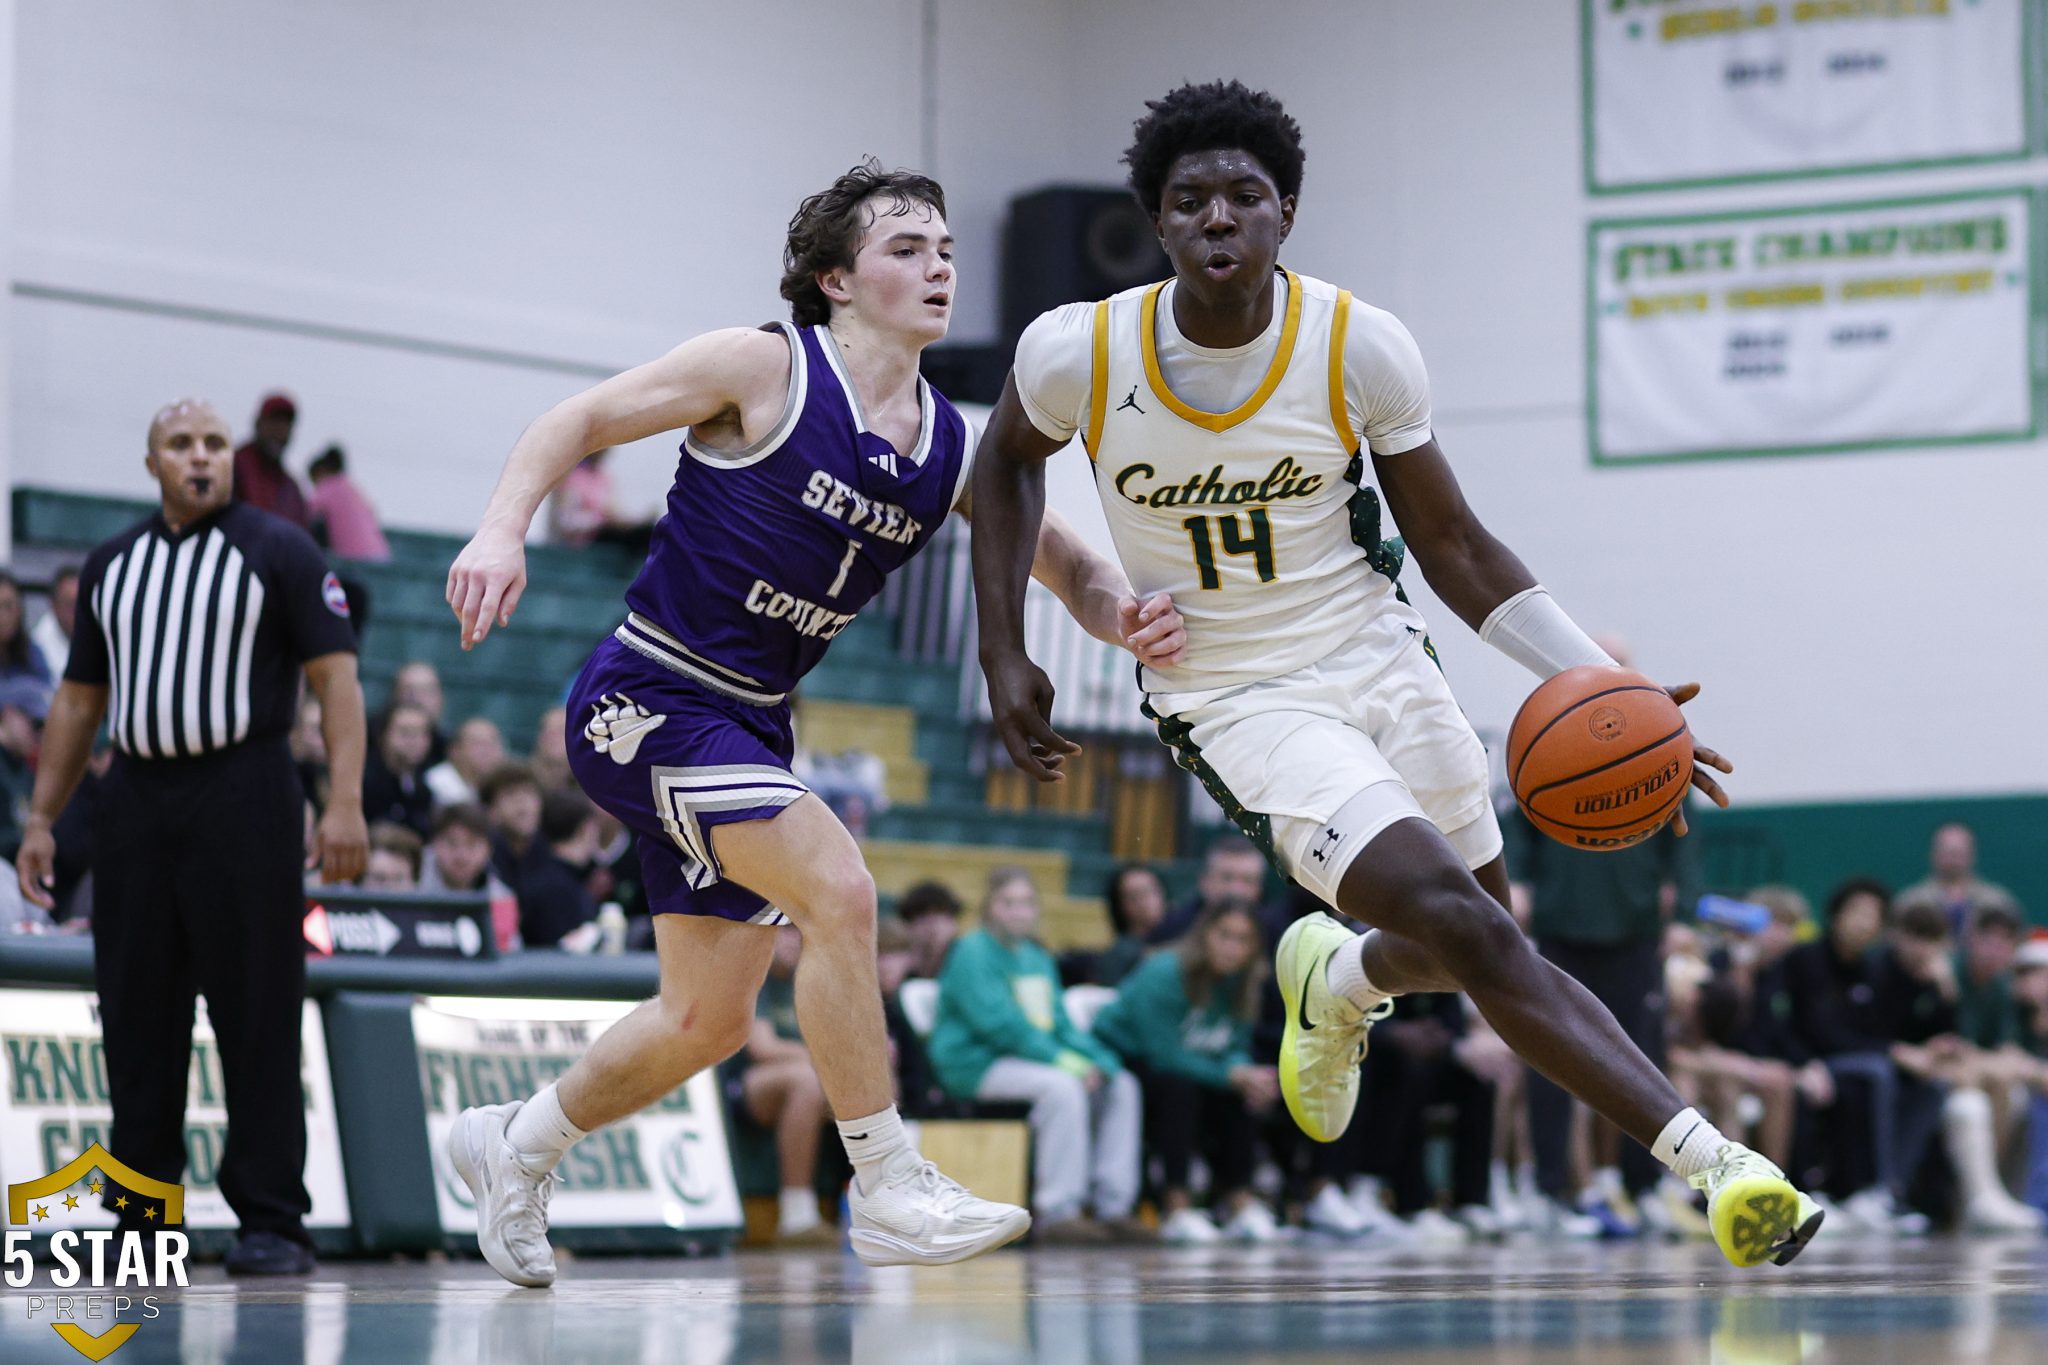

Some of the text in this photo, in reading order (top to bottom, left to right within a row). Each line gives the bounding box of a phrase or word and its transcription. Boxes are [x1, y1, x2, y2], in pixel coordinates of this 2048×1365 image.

[801, 469, 922, 545] SEVIER
[1115, 456, 1322, 508] Catholic
[826, 539, 862, 600] 1
[1181, 505, 1280, 591] 14
[1574, 760, 1679, 815] EVOLUTION
